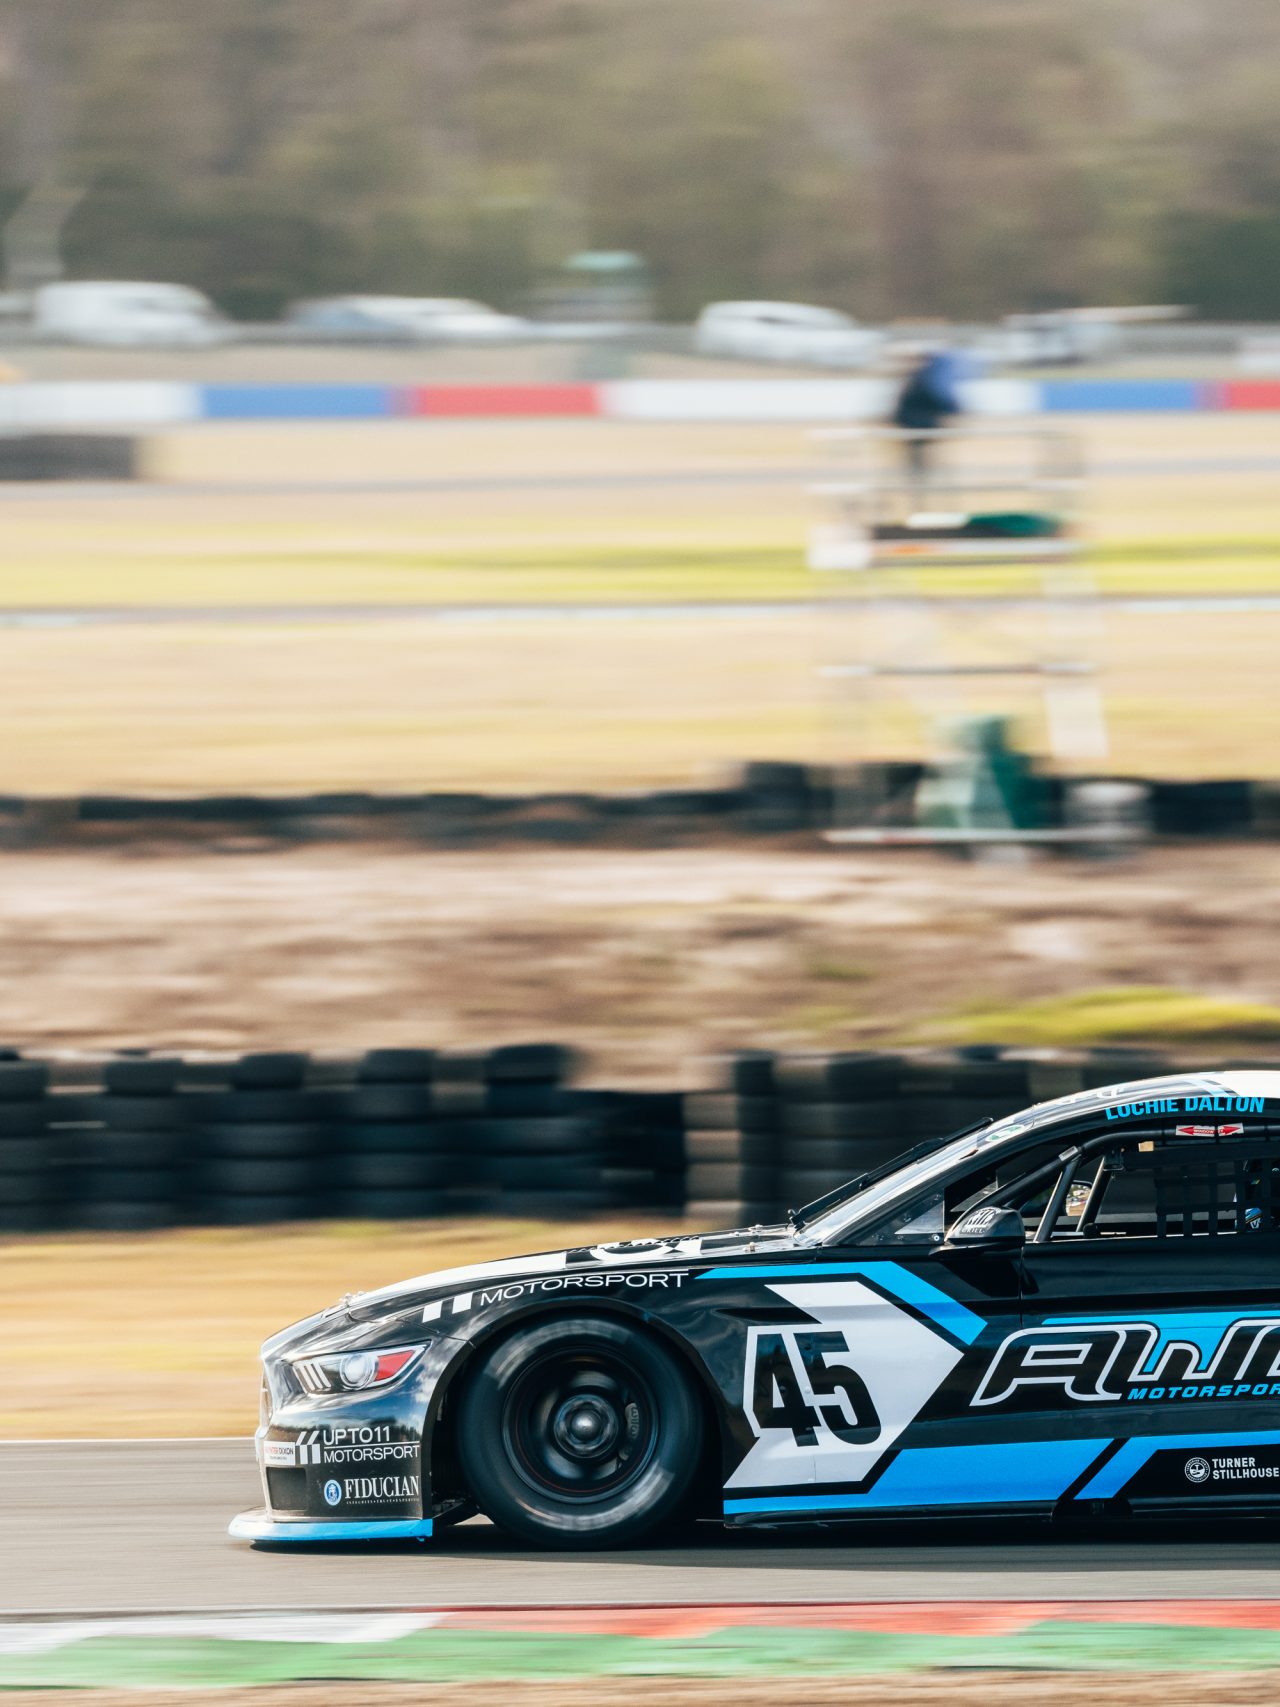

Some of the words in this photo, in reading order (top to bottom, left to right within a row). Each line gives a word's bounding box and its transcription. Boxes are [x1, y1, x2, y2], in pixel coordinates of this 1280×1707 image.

[1105, 1098, 1179, 1120] LOCHIE
[1185, 1096, 1265, 1113] DALTON
[479, 1273, 689, 1306] MOTORSPORT
[752, 1330, 882, 1447] 45
[323, 1445, 420, 1464] MOTORSPORT
[1212, 1457, 1256, 1468] TURNER
[1212, 1467, 1280, 1480] STILLHOUSE
[344, 1475, 420, 1499] FIDUCIAN
